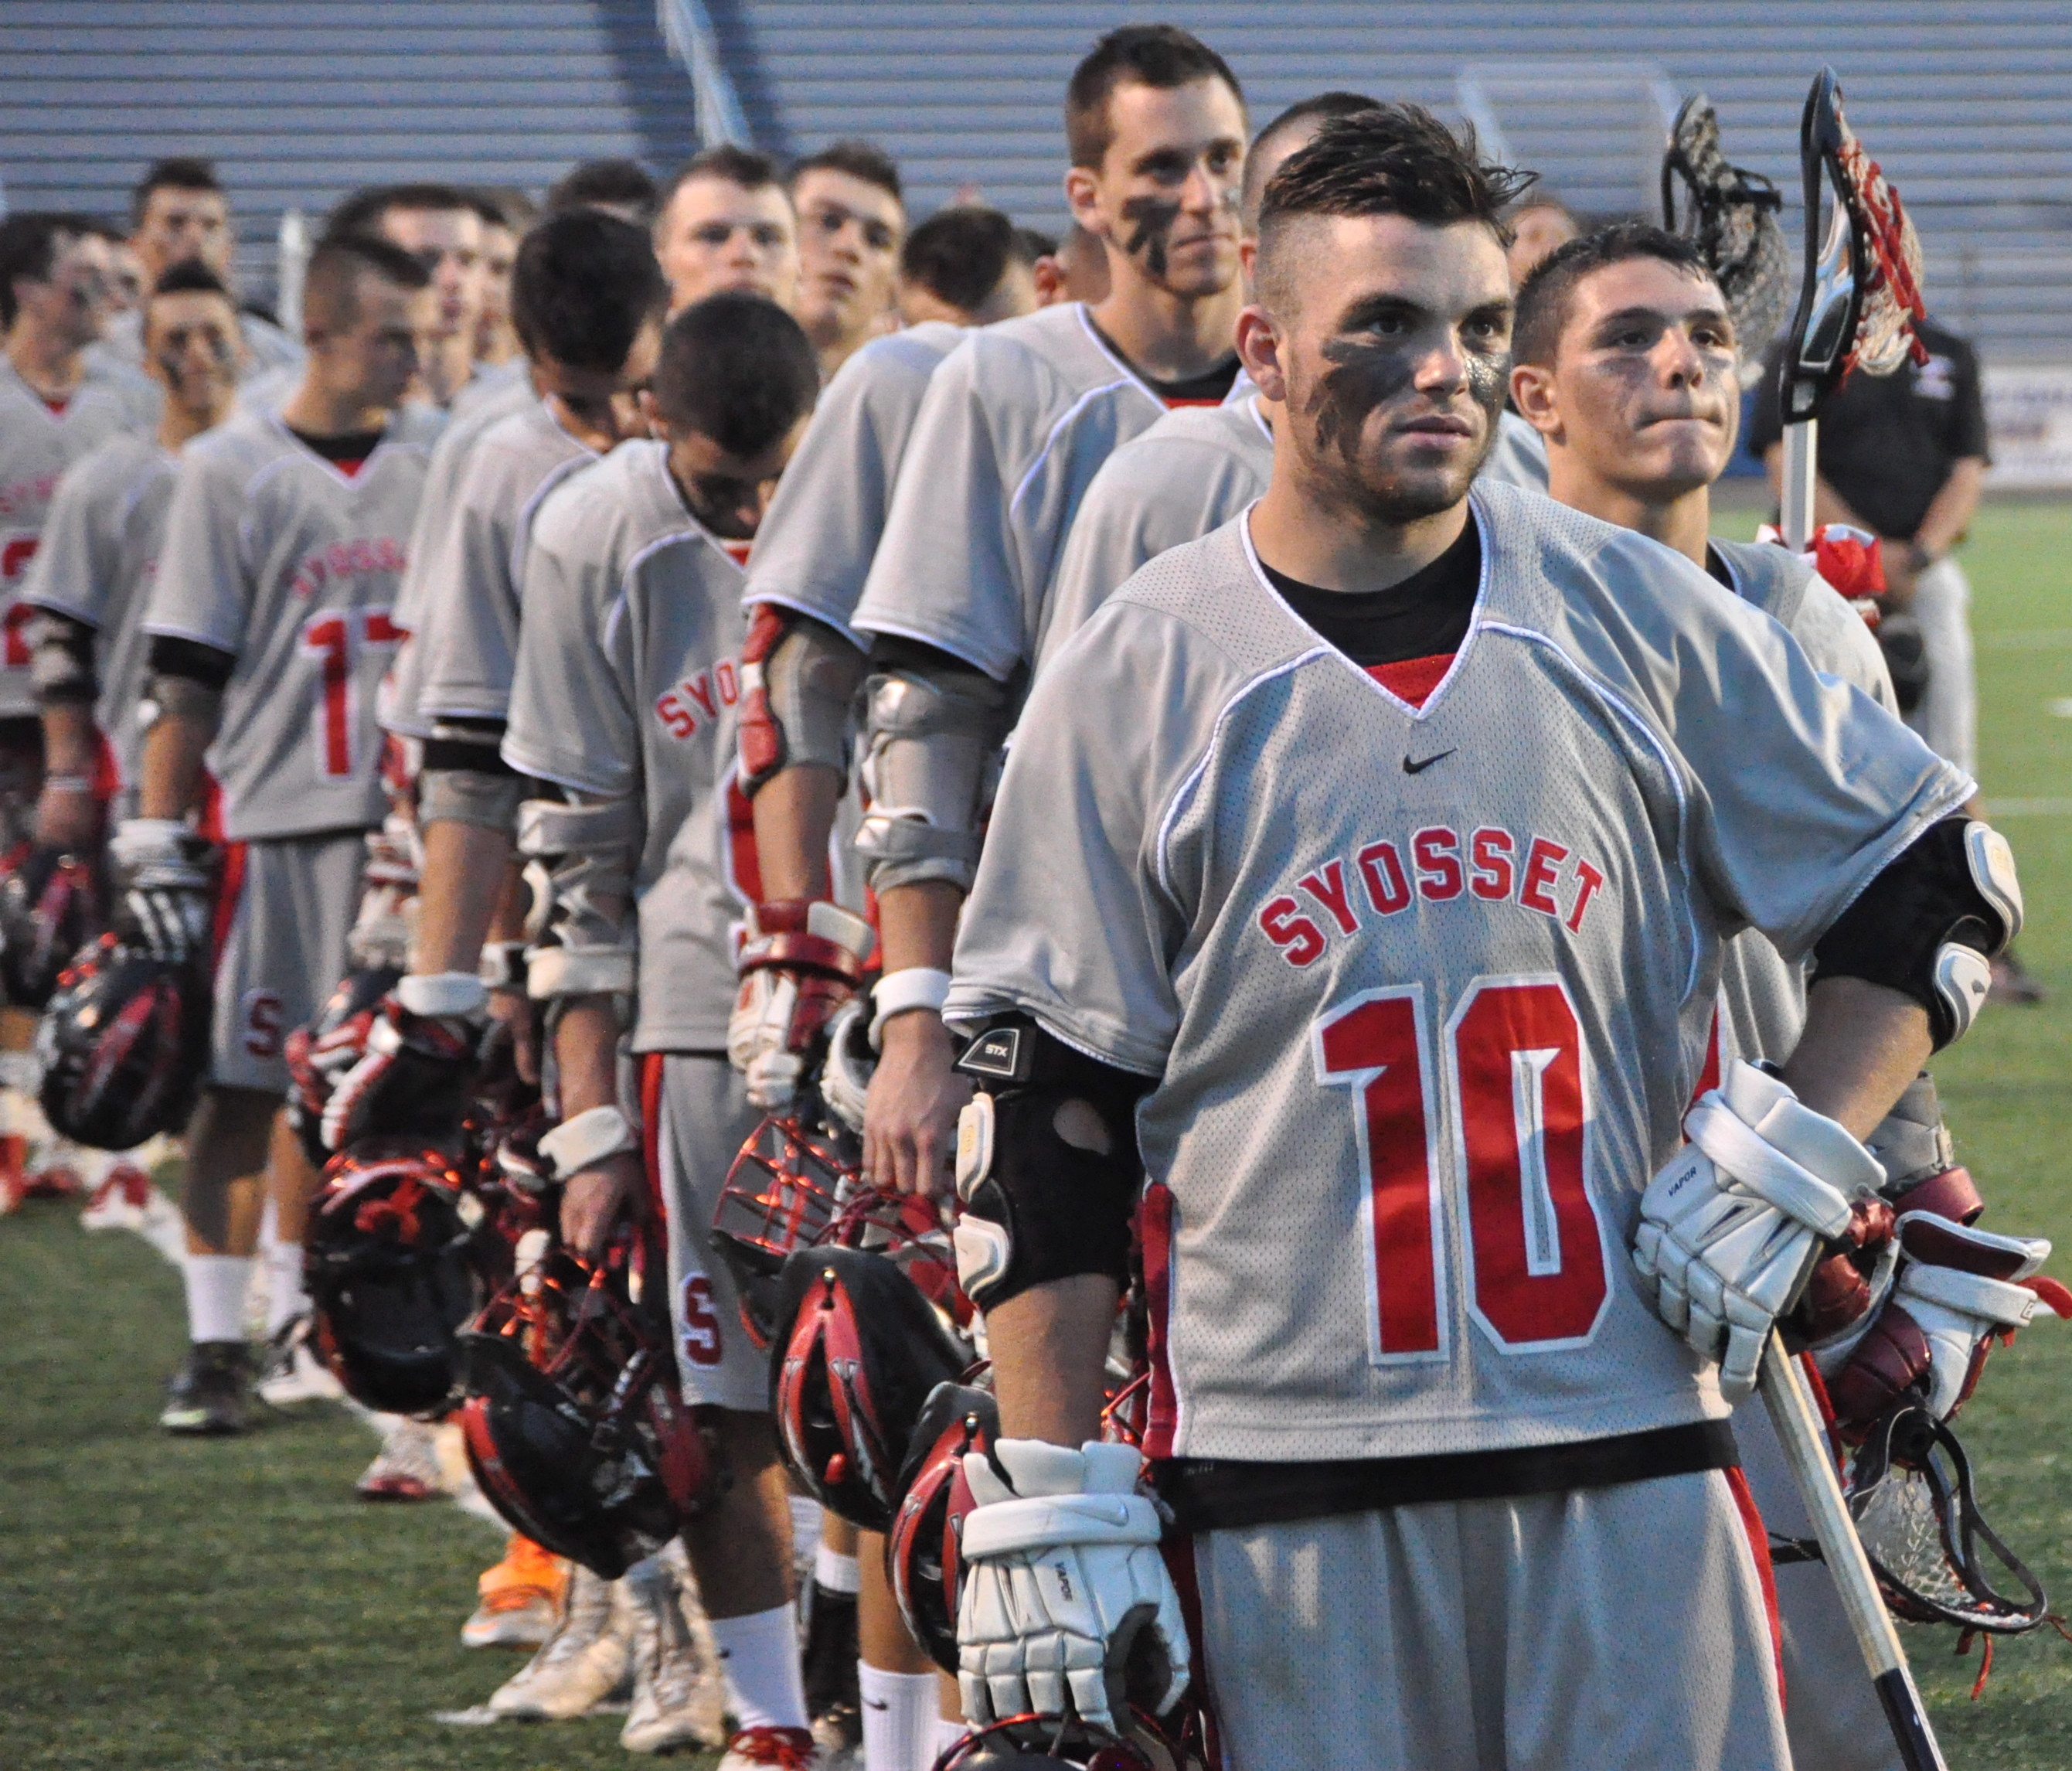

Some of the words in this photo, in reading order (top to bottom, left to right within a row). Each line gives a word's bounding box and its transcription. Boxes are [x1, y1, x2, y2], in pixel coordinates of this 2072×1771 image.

[1257, 825, 1604, 969] SYOSSET
[985, 1043, 1009, 1057] STX
[1311, 972, 1614, 1365] 10
[1668, 1165, 1697, 1197] VAPOR
[681, 1271, 723, 1370] S
